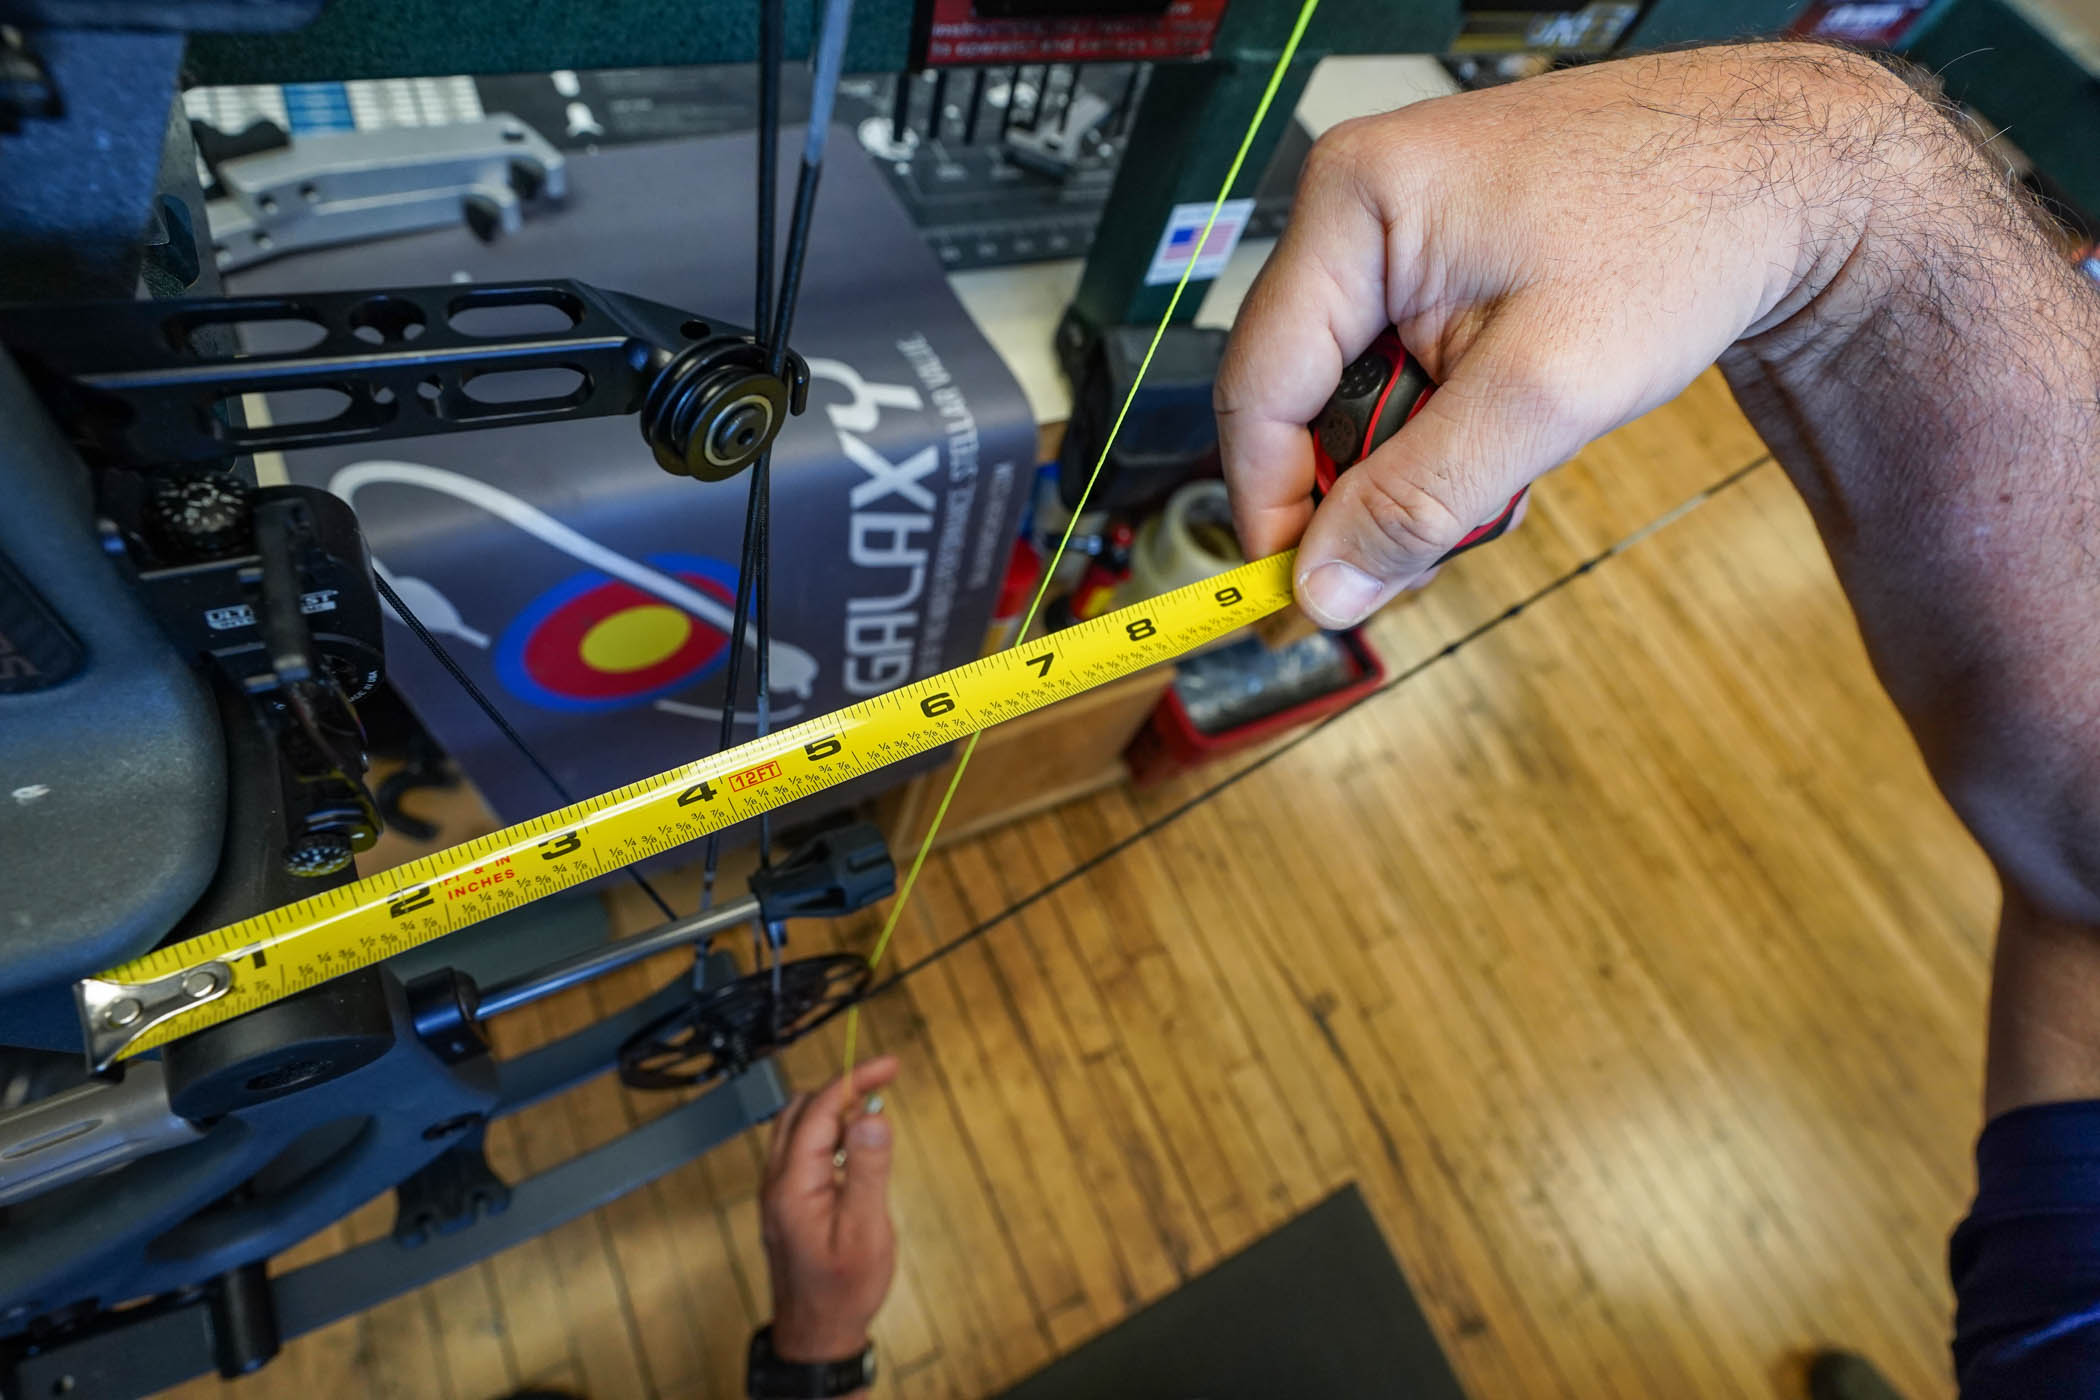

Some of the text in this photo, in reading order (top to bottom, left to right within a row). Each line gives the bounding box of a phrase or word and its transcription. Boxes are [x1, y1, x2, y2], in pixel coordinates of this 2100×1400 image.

[806, 357, 940, 697] GALAXY
[1215, 587, 1242, 607] 9
[1126, 618, 1156, 641] 8
[1026, 652, 1054, 678] 7
[920, 692, 955, 718] 6
[804, 734, 841, 761] 5
[866, 718, 966, 759] 1/8 1/4 3/8 1/2 5/8 3/4 7/8
[735, 763, 776, 787] 12FT
[744, 762, 850, 806] 1/8 1/4 3/8 1/2 5/8 3/4 7/8
[677, 781, 717, 807] 4
[624, 837, 637, 847] 1/4
[658, 824, 672, 835] 1/2
[676, 821, 692, 832] 5/8
[691, 811, 705, 822] 3/4
[710, 808, 725, 818] 7/8
[538, 829, 581, 860] 3
[495, 855, 511, 866] IN
[552, 864, 567, 873] 3/4
[448, 869, 515, 900] INCHES
[387, 882, 434, 919] 2
